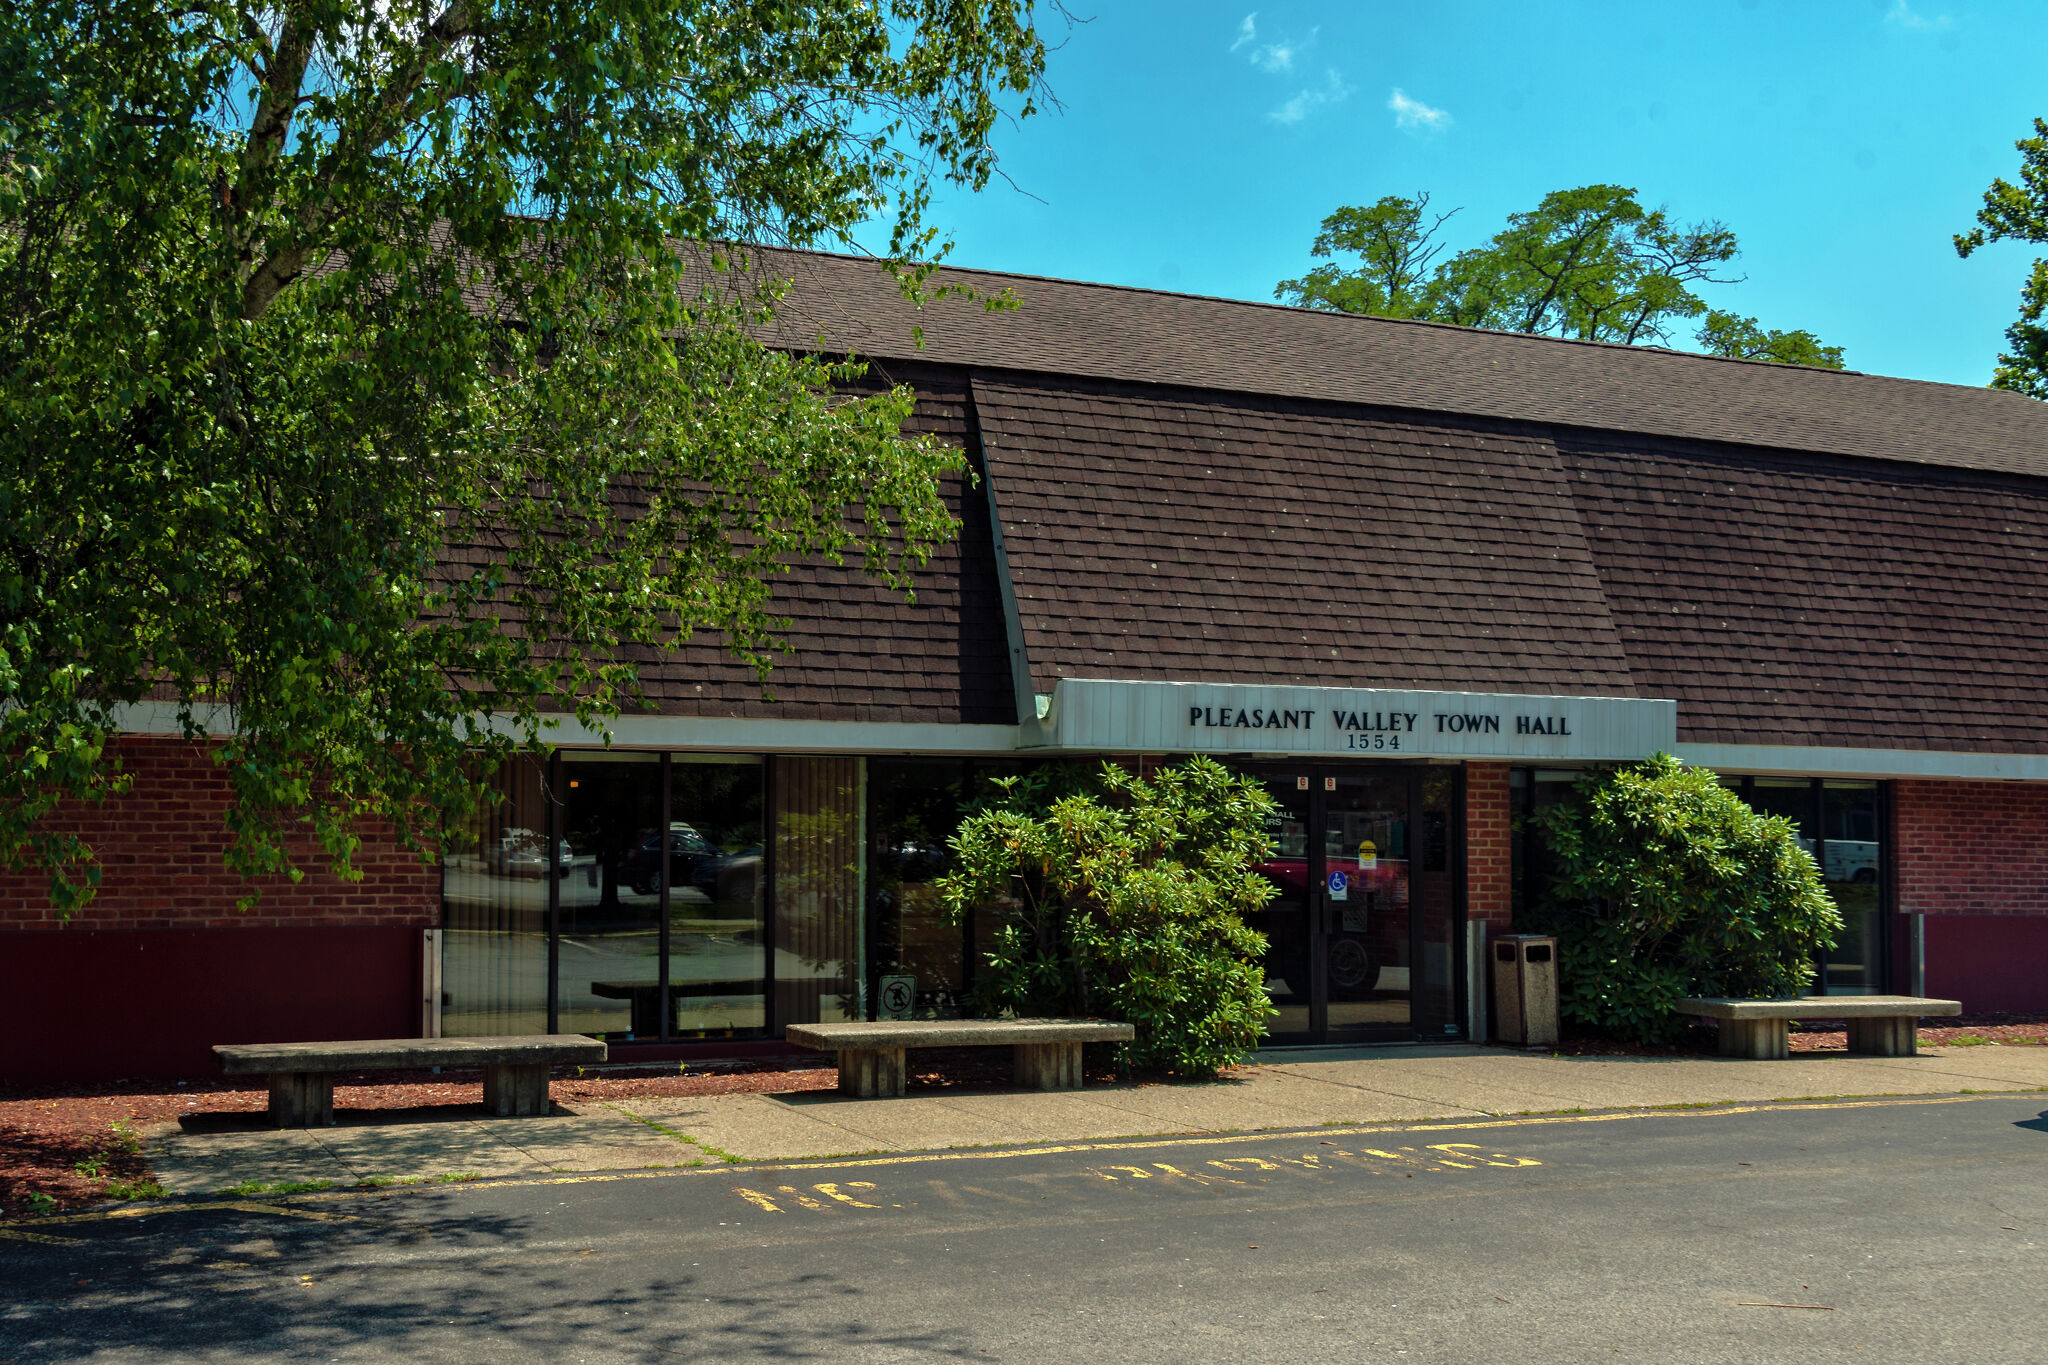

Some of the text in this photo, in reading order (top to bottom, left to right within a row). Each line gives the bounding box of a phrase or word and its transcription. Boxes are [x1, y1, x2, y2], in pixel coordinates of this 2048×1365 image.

[1189, 707, 1572, 736] PLEASANT VALLEY TOWN HALL
[1348, 734, 1400, 750] 1554
